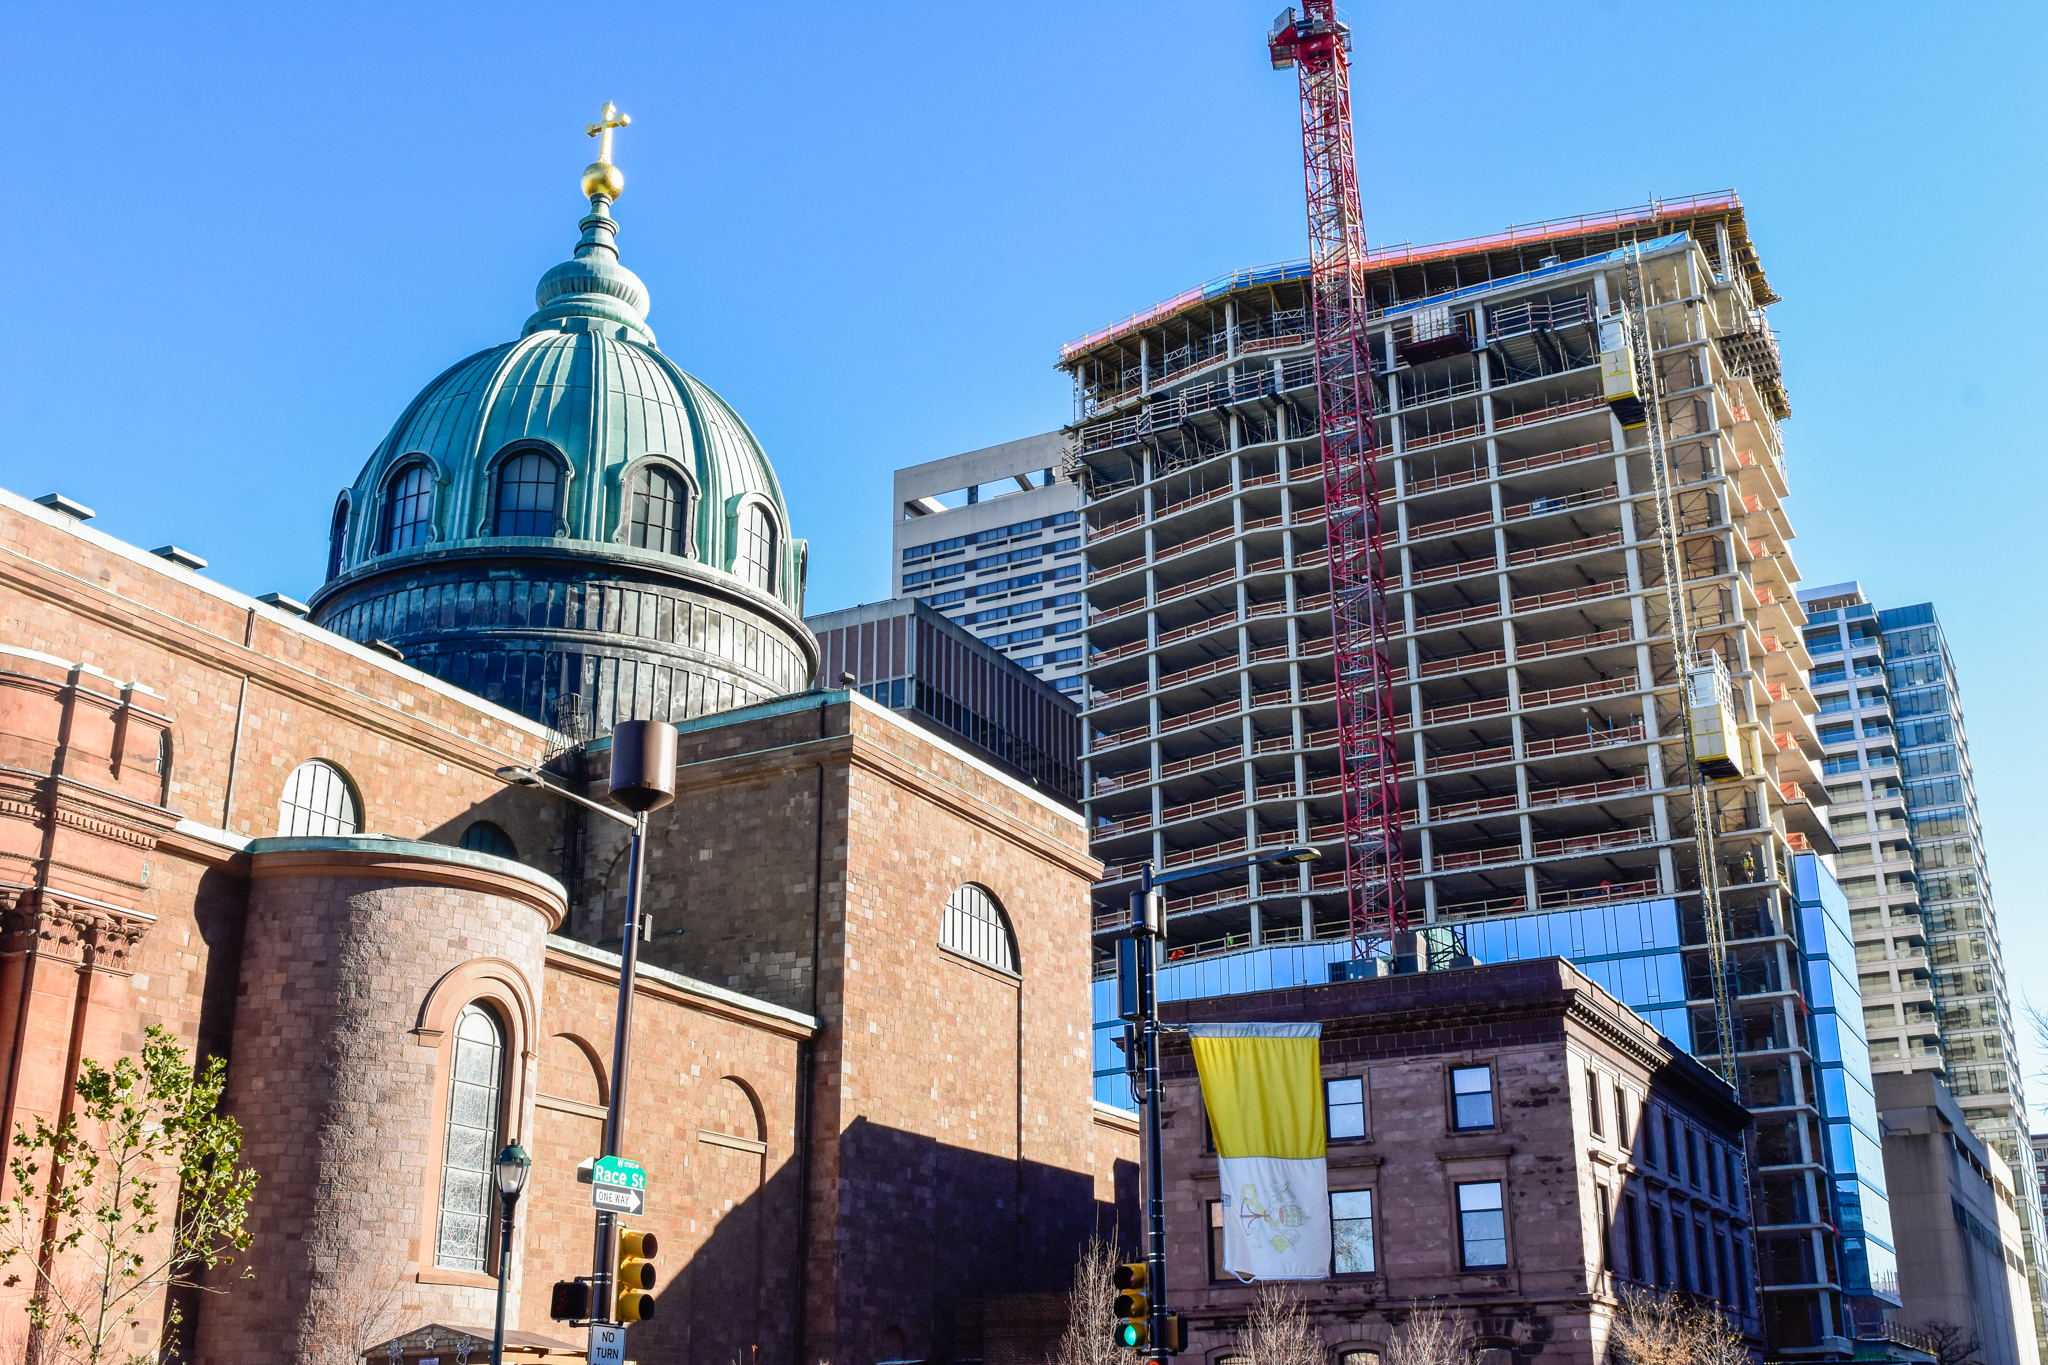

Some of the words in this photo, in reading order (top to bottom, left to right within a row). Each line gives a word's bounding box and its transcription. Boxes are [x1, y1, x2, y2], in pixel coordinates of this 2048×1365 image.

[618, 1159, 624, 1168] W
[595, 1165, 627, 1185] Race
[631, 1173, 644, 1188] St
[598, 1192, 613, 1202] ONE
[615, 1193, 630, 1205] WAY
[602, 1332, 615, 1342] NO
[596, 1348, 619, 1360] TURN
